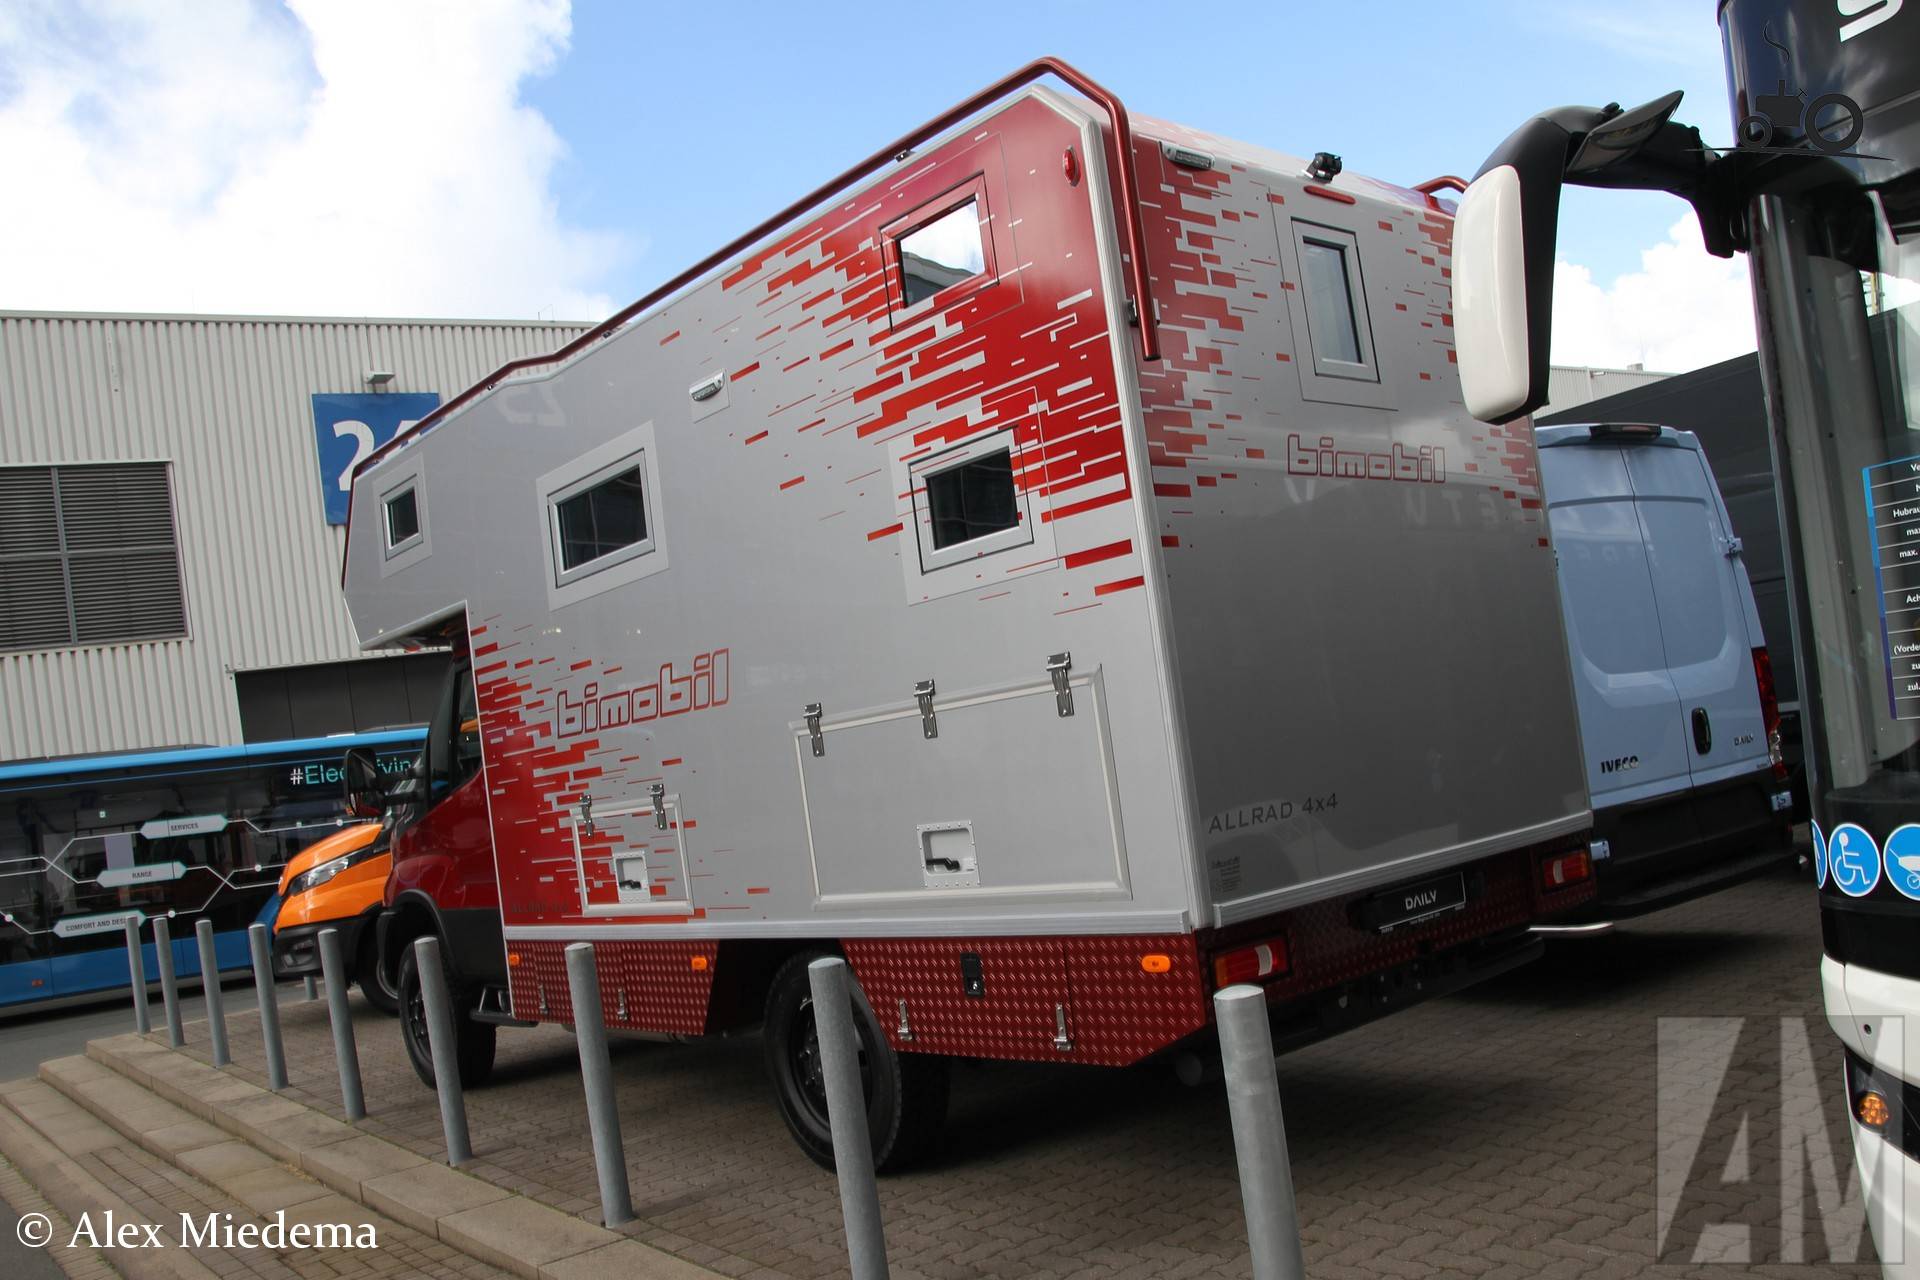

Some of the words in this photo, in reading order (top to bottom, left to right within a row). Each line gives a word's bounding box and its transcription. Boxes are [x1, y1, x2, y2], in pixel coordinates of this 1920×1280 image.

[1287, 434, 1446, 483] bimobil
[1899, 549, 1918, 558] max.
[557, 648, 729, 739] bimobil
[1600, 755, 1639, 774] IVECO
[1208, 801, 1293, 835] ALLRAD
[1301, 792, 1338, 814] 4x4
[170, 822, 199, 832] SERVICES
[132, 870, 152, 879] RANGE
[1405, 889, 1437, 911] DAILY
[65, 921, 95, 932] COMFORT
[96, 919, 110, 928] AND
